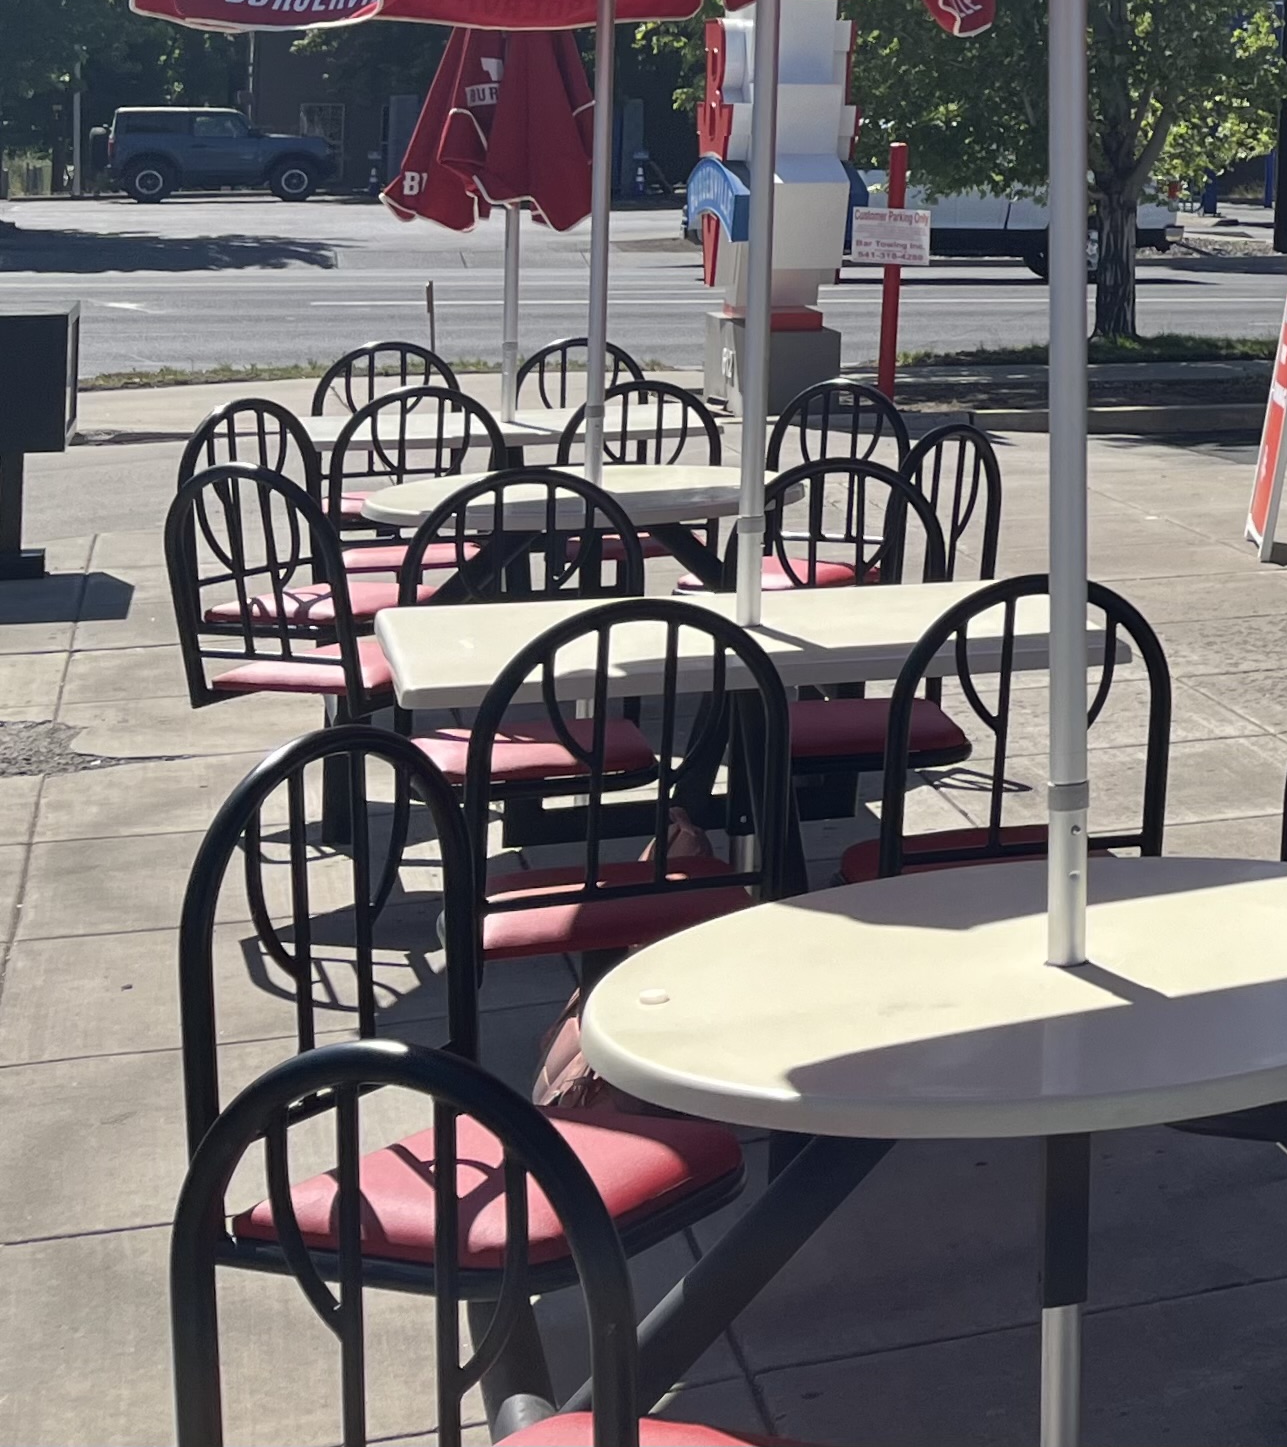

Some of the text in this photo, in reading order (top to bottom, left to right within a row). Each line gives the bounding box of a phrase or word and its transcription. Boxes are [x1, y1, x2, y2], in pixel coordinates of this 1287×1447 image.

[854, 209, 929, 227] Customer Parking Only
[876, 240, 908, 250] Towing
